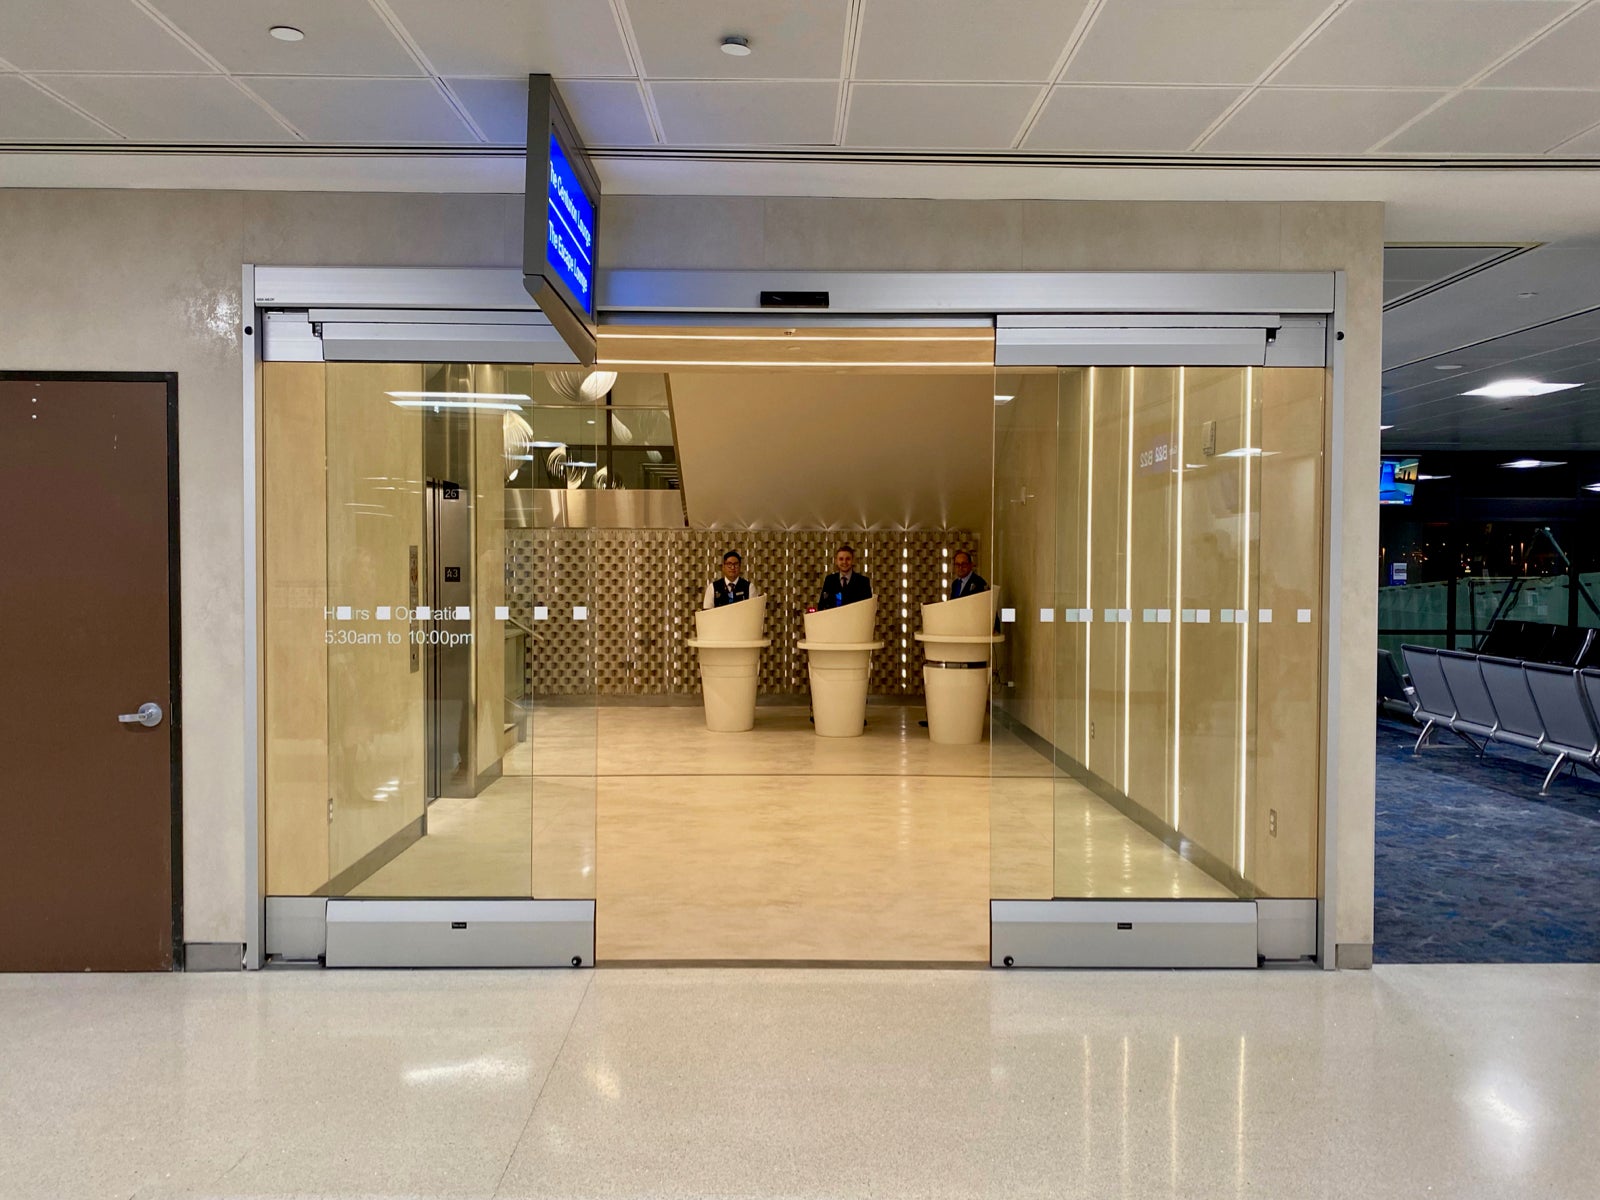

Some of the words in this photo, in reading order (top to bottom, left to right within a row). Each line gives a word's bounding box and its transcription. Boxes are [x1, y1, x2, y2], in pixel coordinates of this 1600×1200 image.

[549, 160, 558, 189] The
[557, 175, 578, 224] Centurion
[577, 210, 591, 247] Lounge
[548, 219, 558, 249] The
[557, 234, 574, 272] Escape
[573, 257, 588, 294] Lounge
[445, 489, 457, 498] 26
[323, 606, 370, 620] Hrs
[395, 605, 471, 624] Oprati
[325, 630, 382, 644] 5:30am
[387, 631, 401, 644] to
[408, 630, 474, 648] 10:00pm
